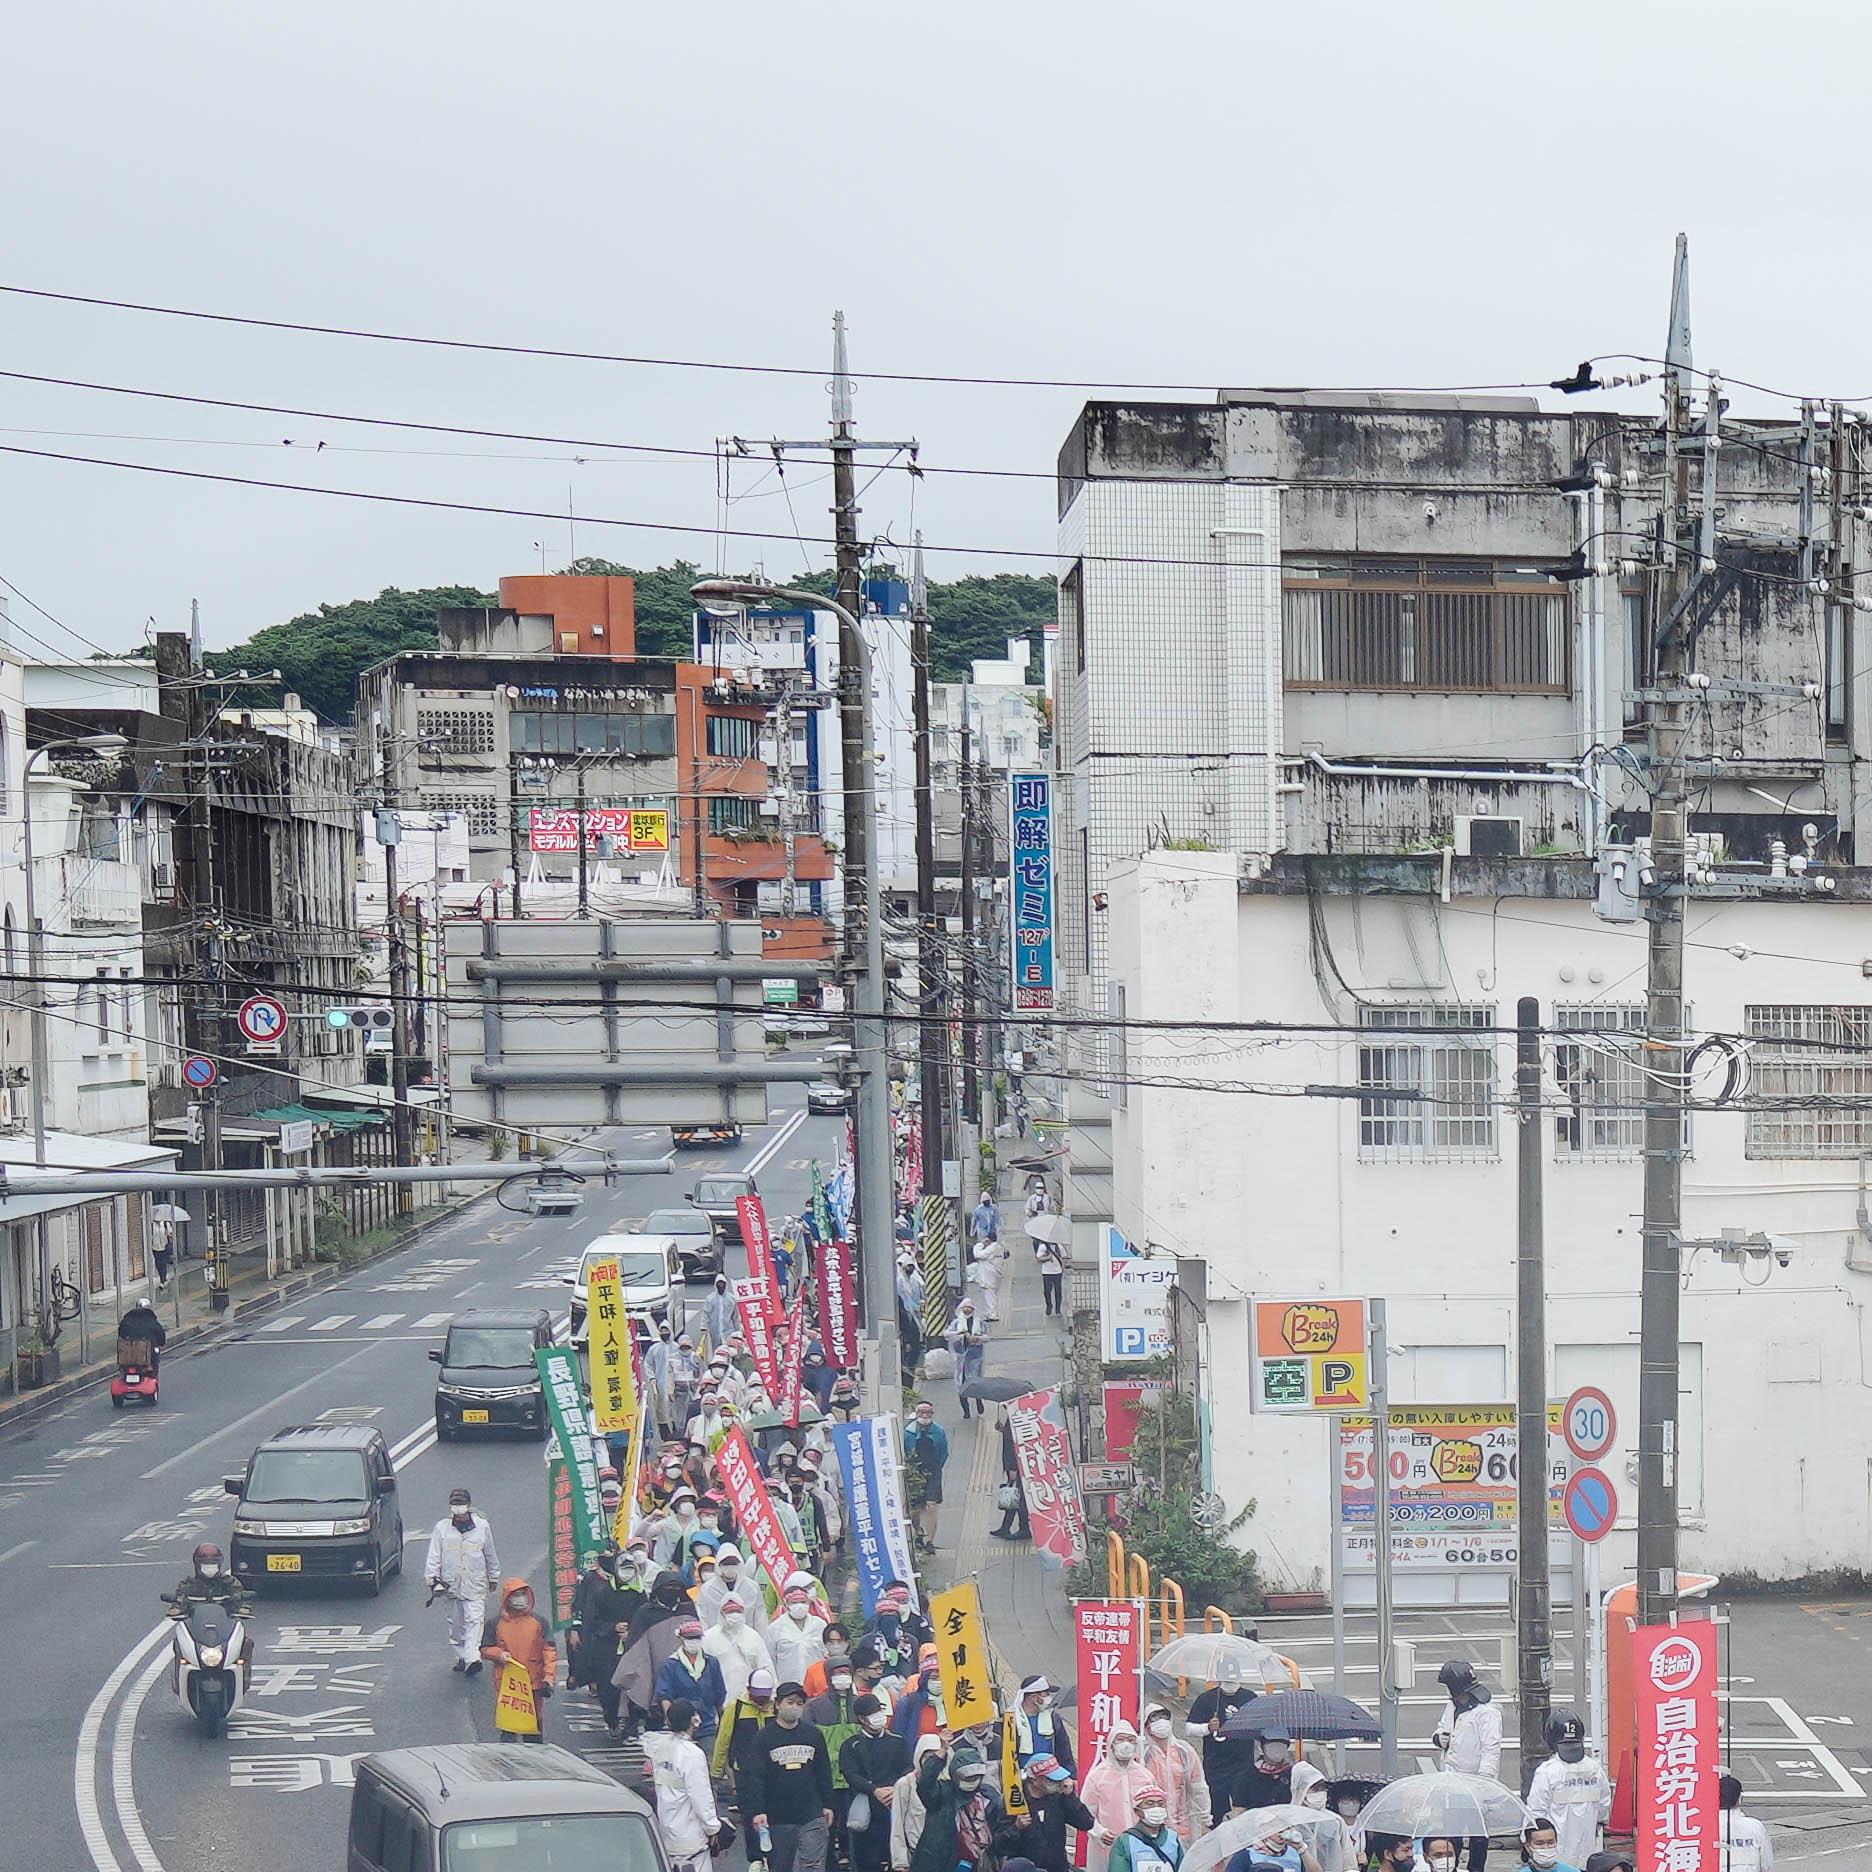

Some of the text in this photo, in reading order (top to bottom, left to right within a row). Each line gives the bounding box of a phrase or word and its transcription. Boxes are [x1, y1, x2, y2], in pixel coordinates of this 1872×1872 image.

[633, 827, 653, 840] 3F
[1014, 780, 1050, 925] 即解ゼミ
[1121, 1328, 1141, 1353] P
[1291, 1312, 1336, 1345] Break
[1311, 1332, 1334, 1343] 24h
[1322, 1361, 1355, 1394] P
[1573, 1406, 1608, 1442] 30
[1457, 1463, 1478, 1474] 24h
